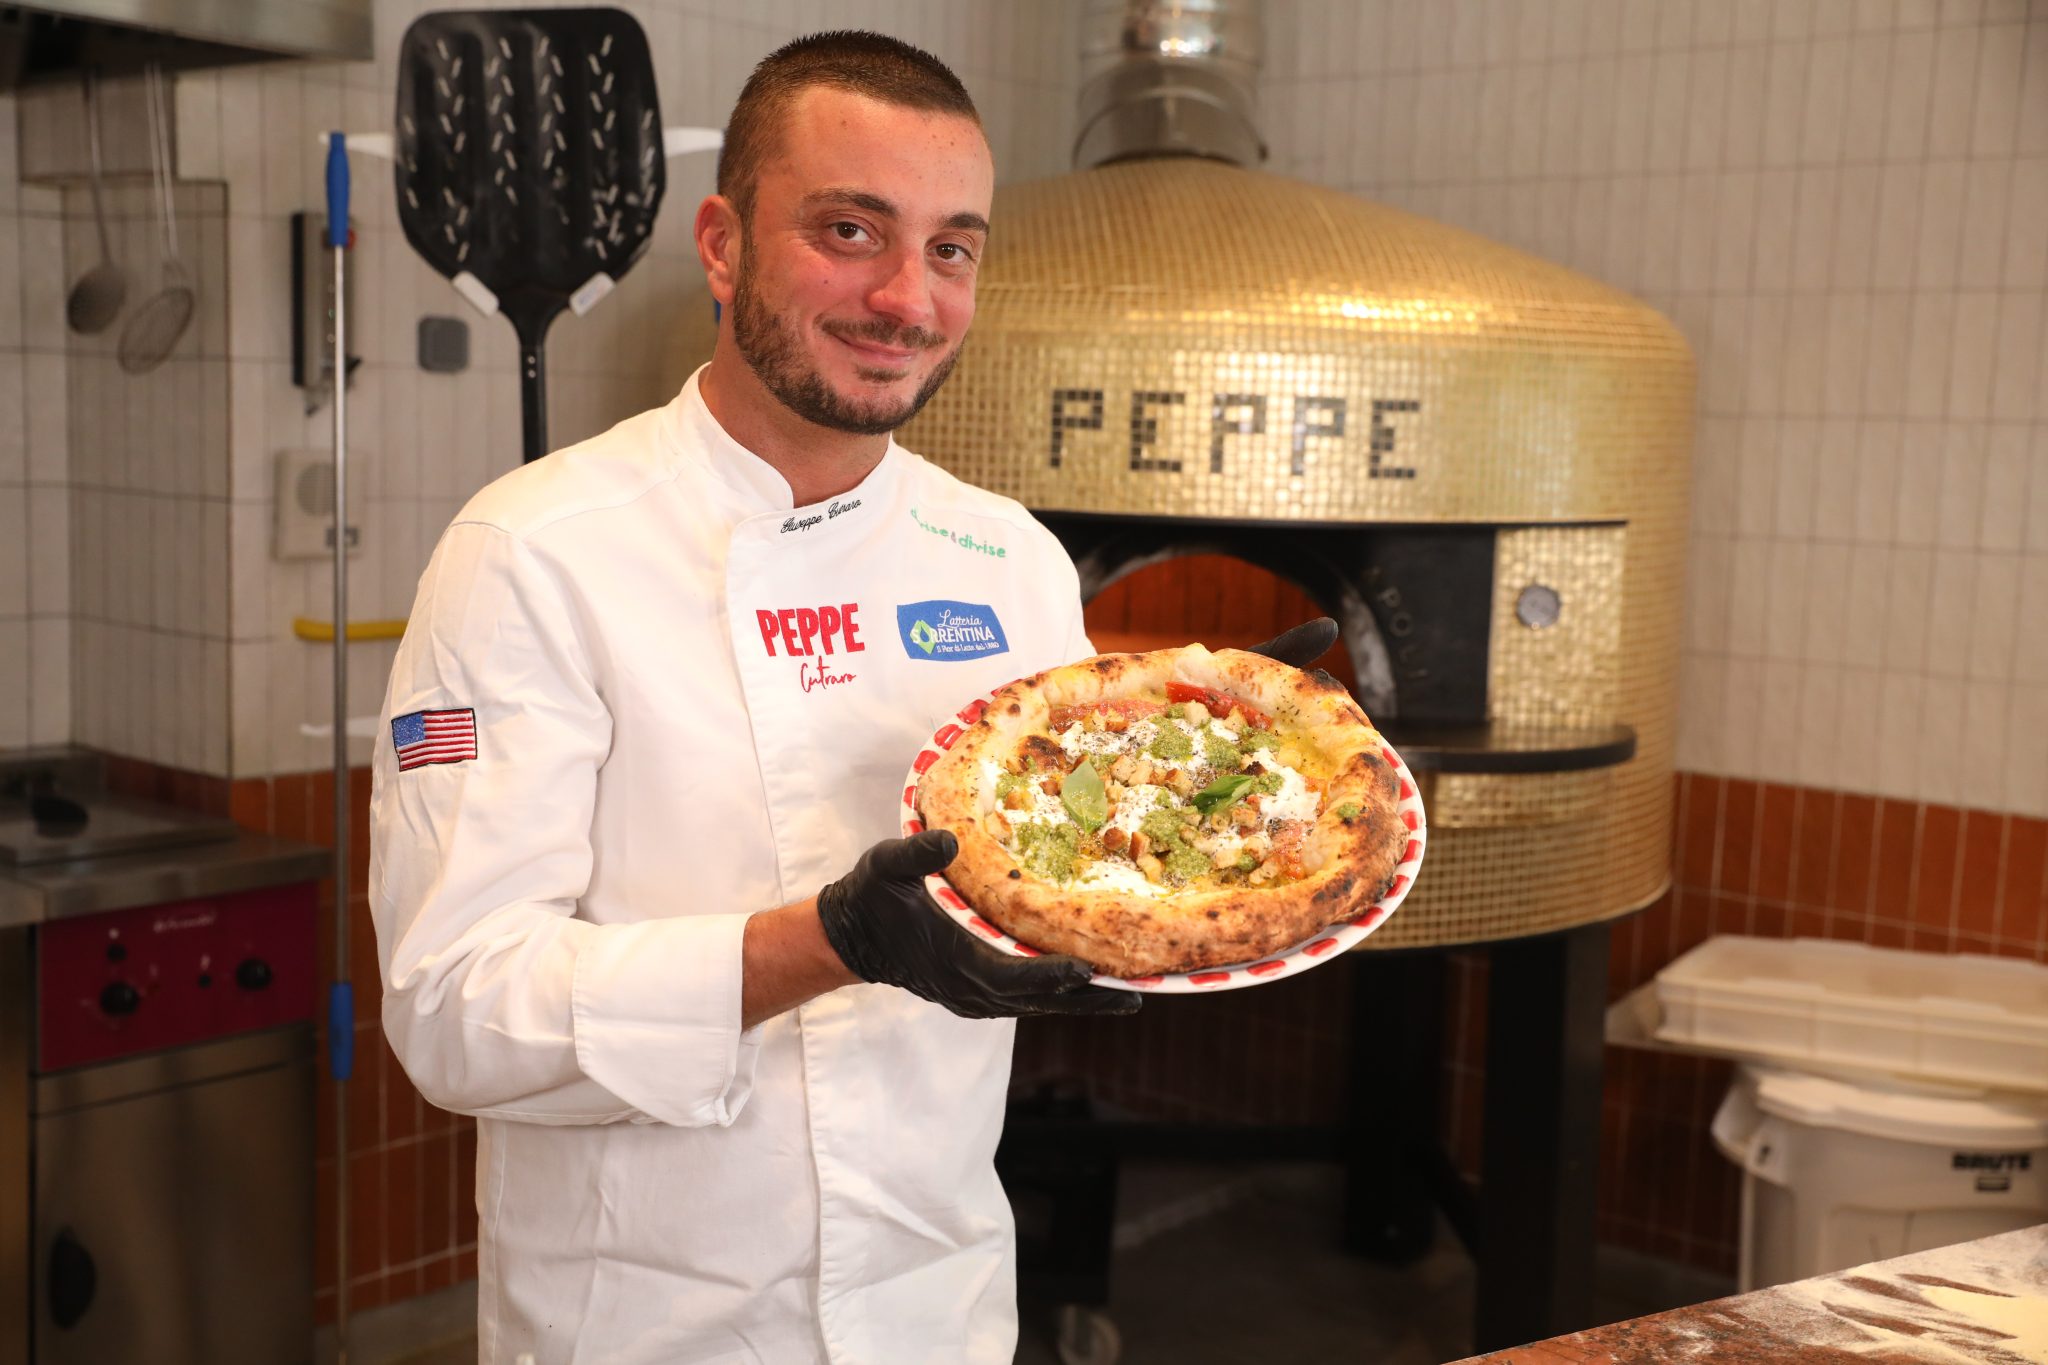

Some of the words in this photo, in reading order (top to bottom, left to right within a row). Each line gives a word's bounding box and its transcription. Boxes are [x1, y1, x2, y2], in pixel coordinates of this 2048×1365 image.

[1050, 389, 1420, 479] PEPPE
[756, 602, 865, 657] PEPPE
[937, 609, 982, 629] Latteria
[800, 655, 857, 693] Cutraro
